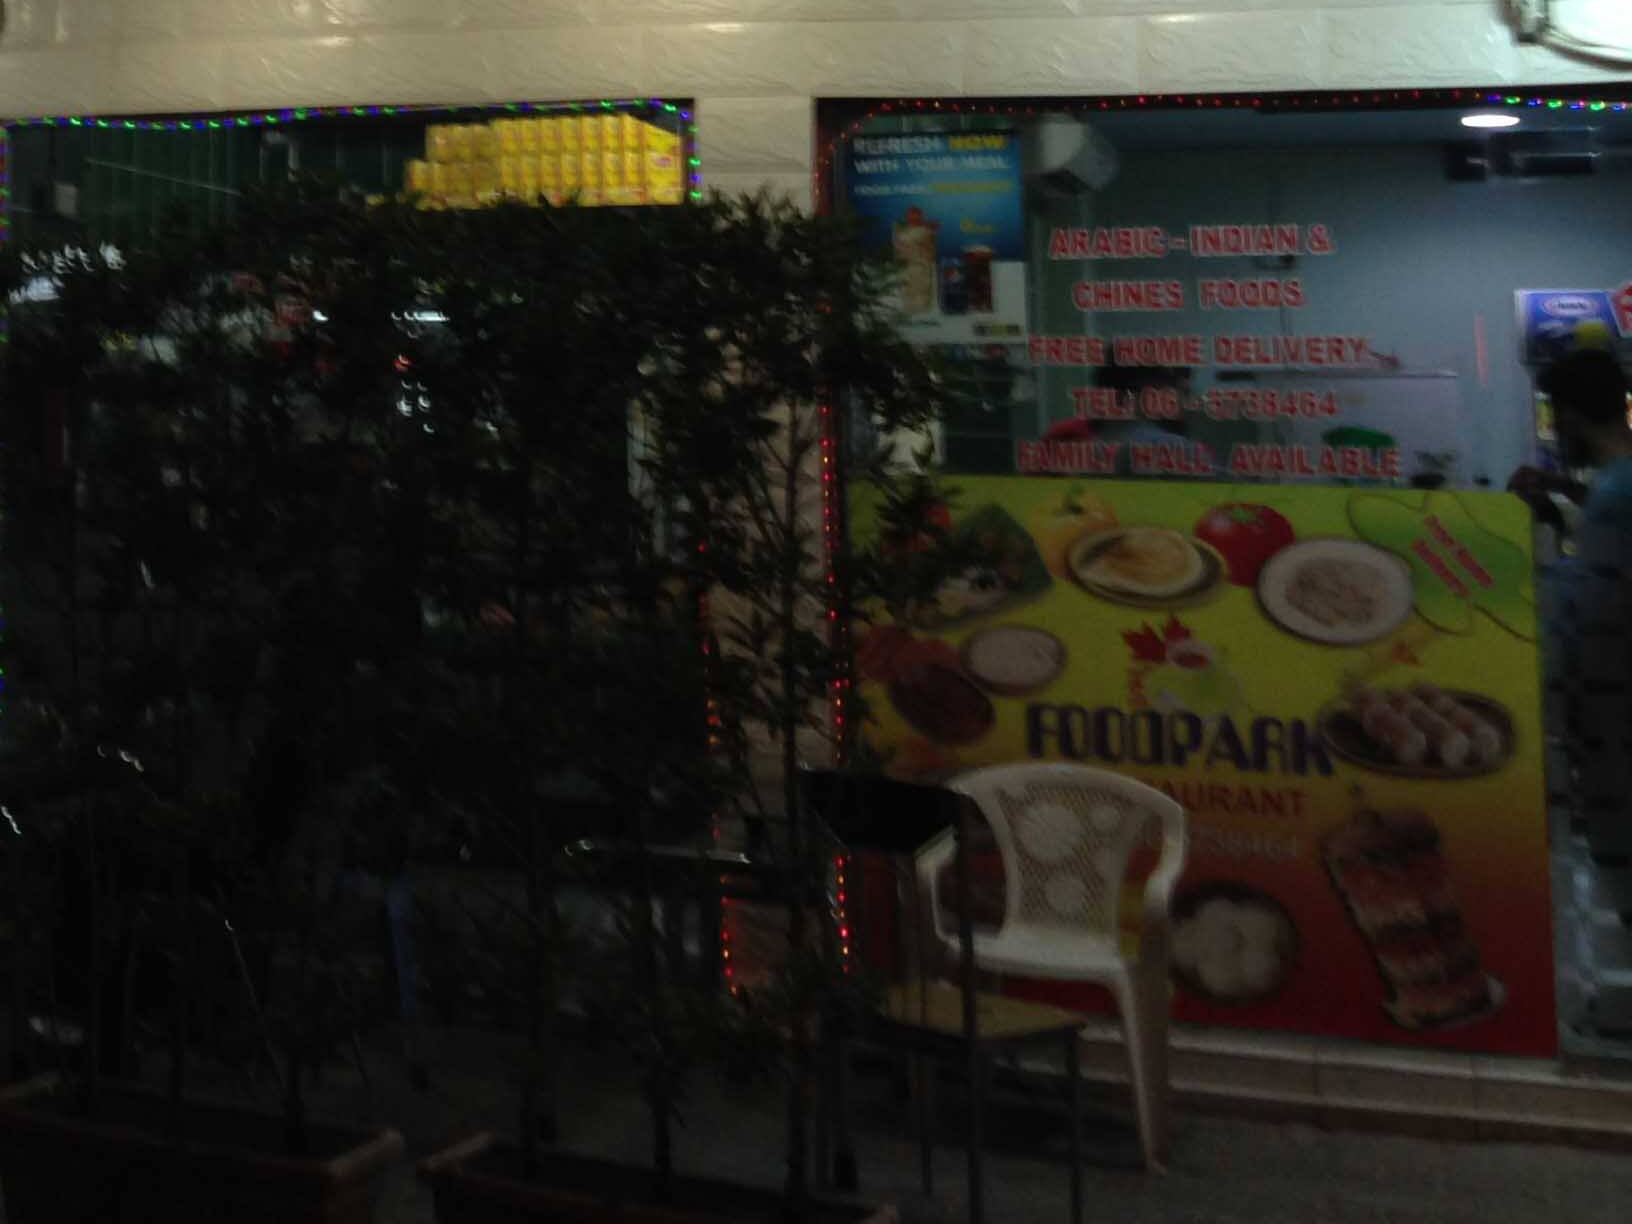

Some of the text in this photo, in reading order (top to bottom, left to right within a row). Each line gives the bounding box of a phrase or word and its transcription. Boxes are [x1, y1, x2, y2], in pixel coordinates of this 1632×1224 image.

[1048, 227, 1167, 260] ARABIC
[1189, 225, 1300, 257] INDIAN
[1308, 224, 1337, 255] &
[1072, 279, 1309, 311] CHINES FOODS
[1027, 335, 1370, 367] FREE HOME DELIVERY
[1017, 439, 1402, 478] FAMILY HALL AVAILABLE
[1026, 702, 1334, 776] FOODPARK
